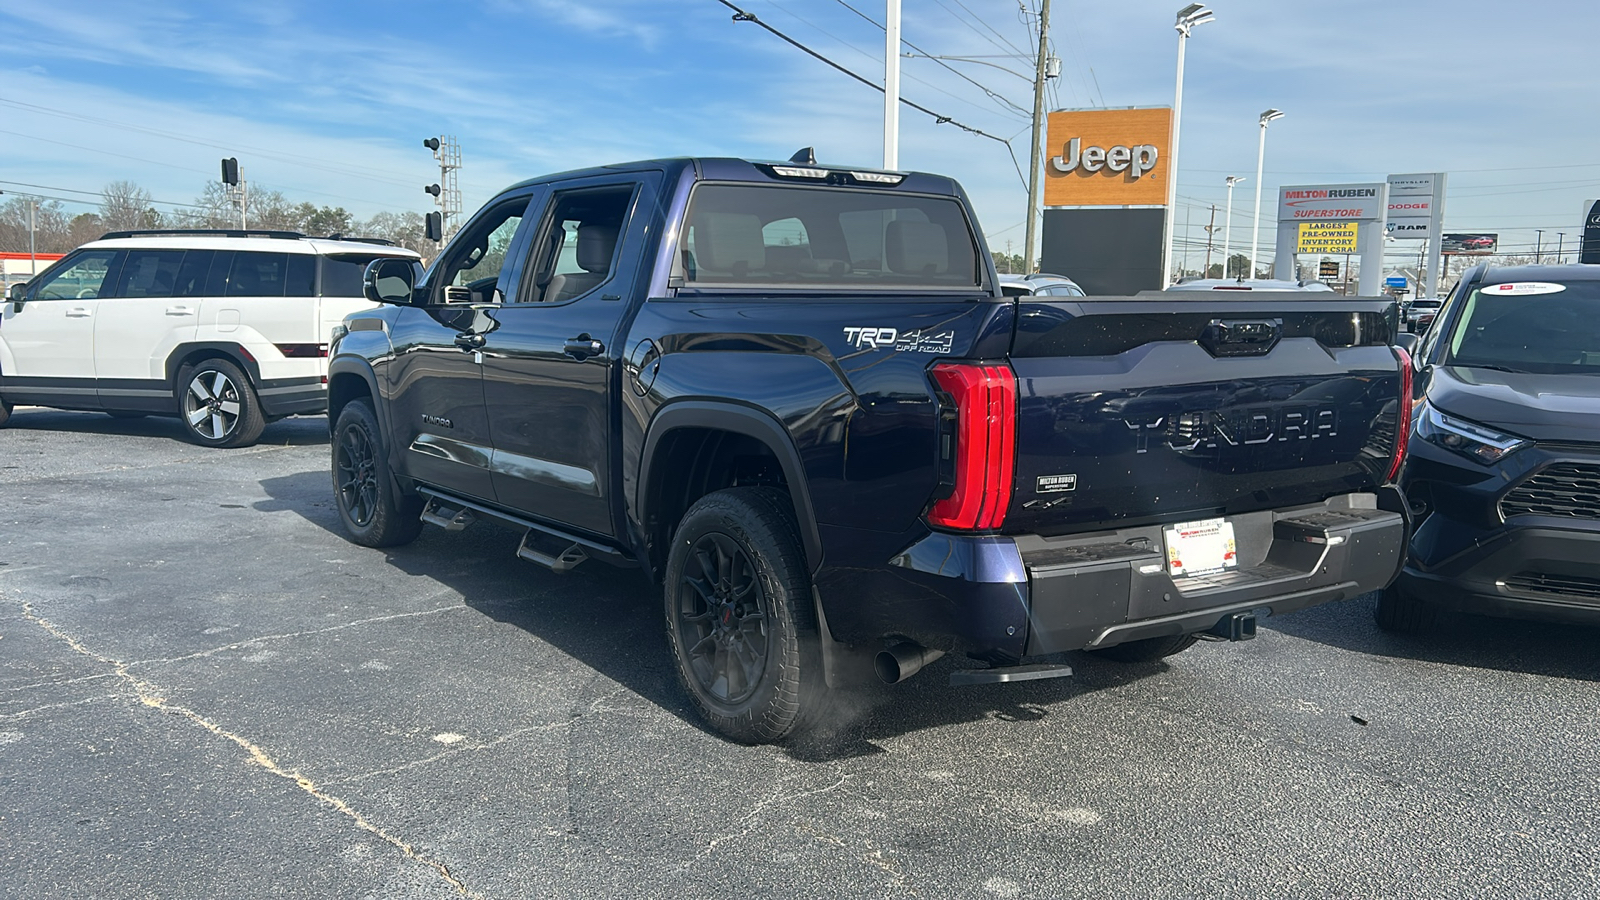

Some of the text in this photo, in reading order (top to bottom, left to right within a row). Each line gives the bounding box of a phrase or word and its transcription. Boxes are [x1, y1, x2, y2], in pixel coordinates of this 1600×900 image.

[1052, 136, 1158, 178] Jeep
[1285, 188, 1376, 199] MILTON RUBEN
[1293, 209, 1363, 218] SUPERSTORE
[843, 327, 897, 348] TRD
[421, 413, 454, 429] TUNDRA
[1123, 406, 1338, 453] TUNDRA
